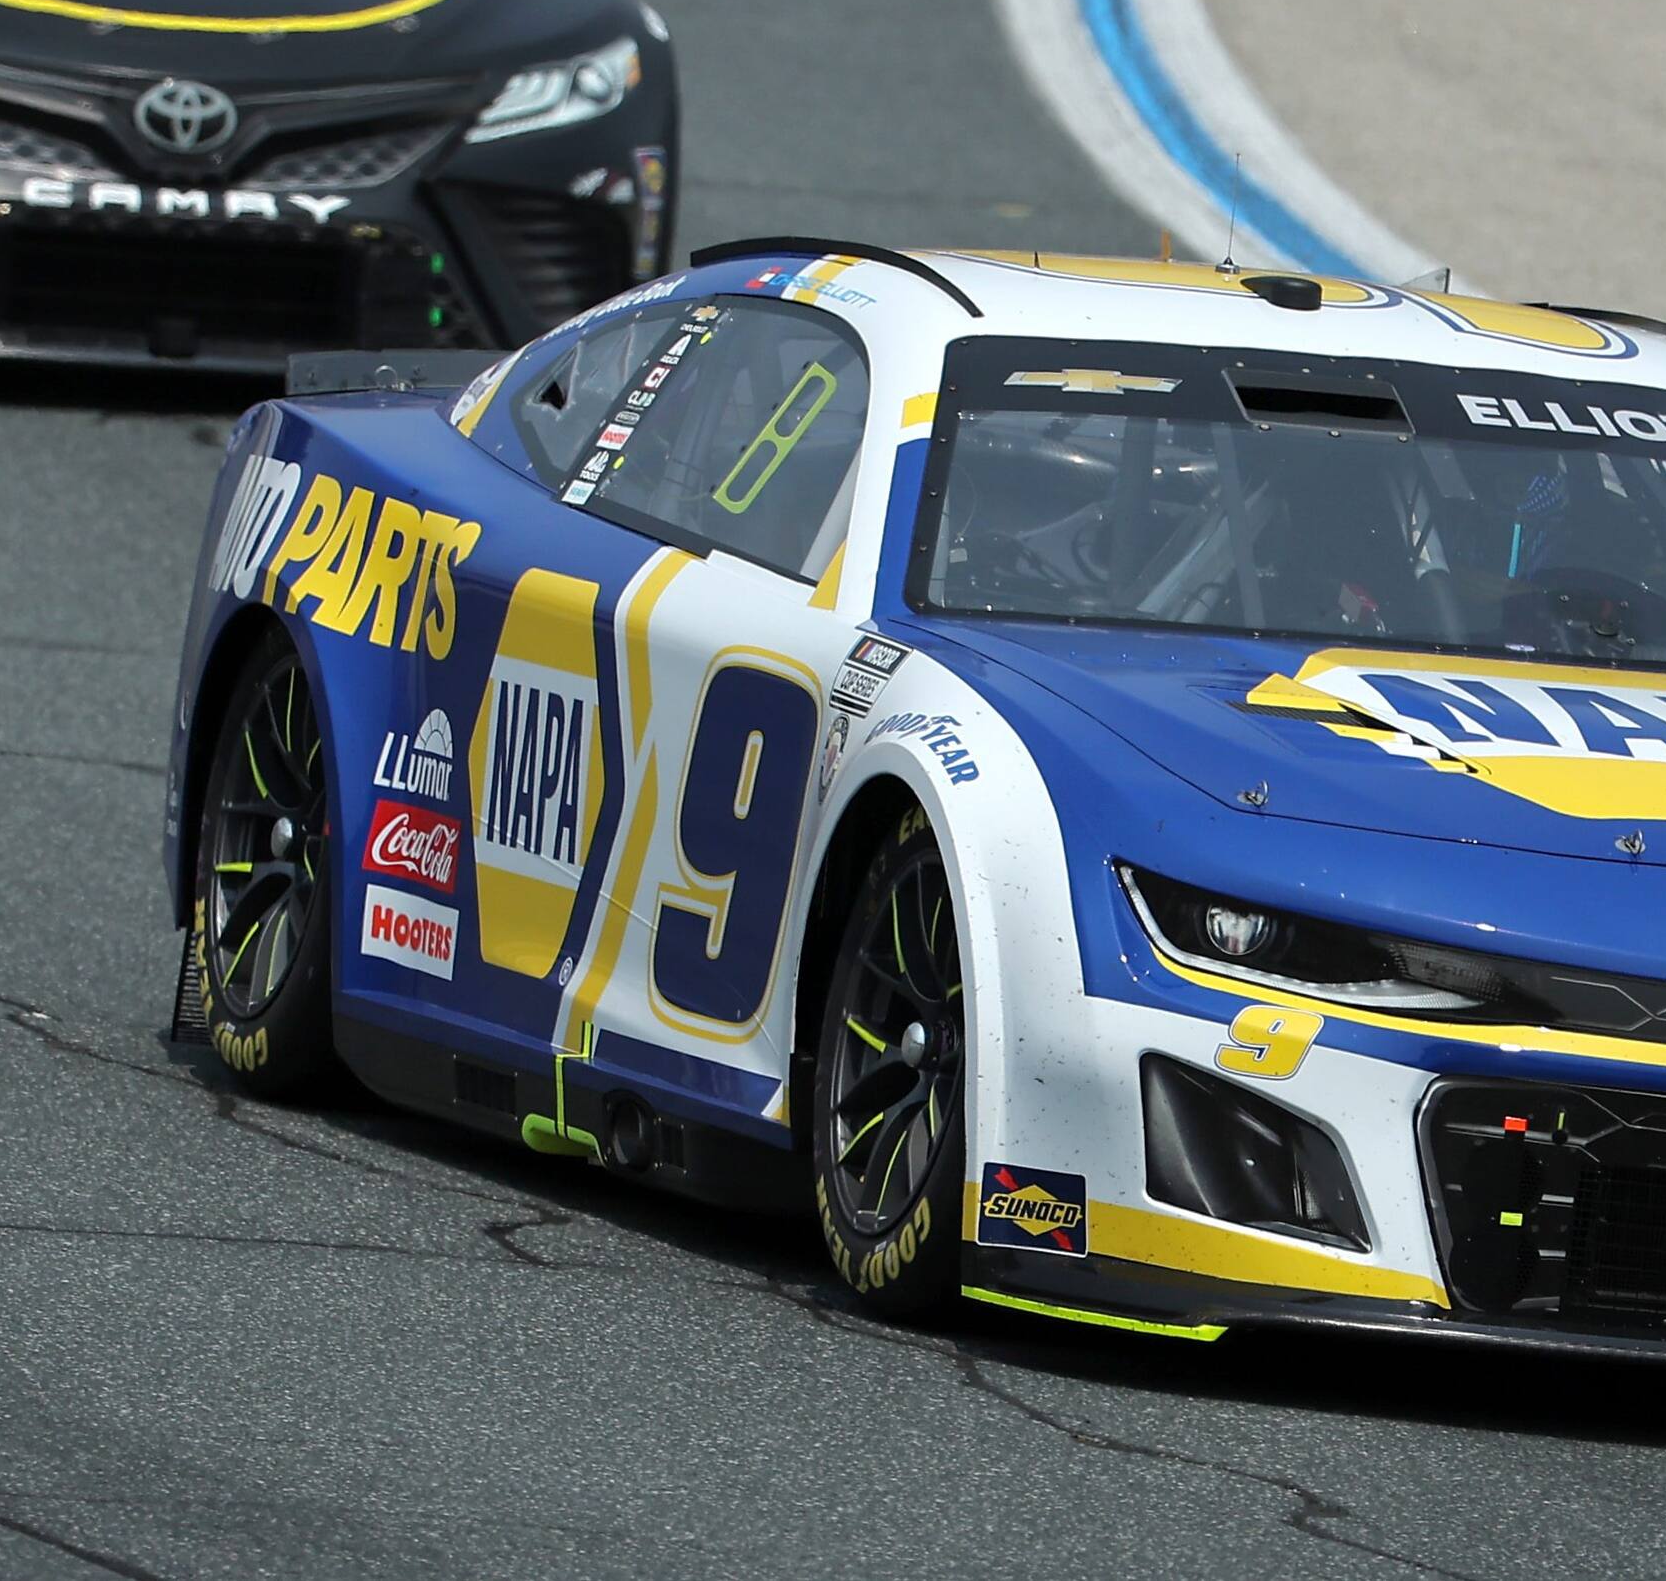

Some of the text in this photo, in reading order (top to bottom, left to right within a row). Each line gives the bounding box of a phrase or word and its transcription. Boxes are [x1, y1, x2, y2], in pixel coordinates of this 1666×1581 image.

[22, 176, 351, 225] CAMRY
[261, 473, 483, 661] PARTS
[373, 730, 453, 802] LLumar
[486, 679, 585, 867] NAPA
[650, 652, 821, 1036] 9
[371, 904, 453, 962] HOOTERS
[1214, 1004, 1325, 1081] 9
[986, 1193, 1081, 1227] SUNOCO
